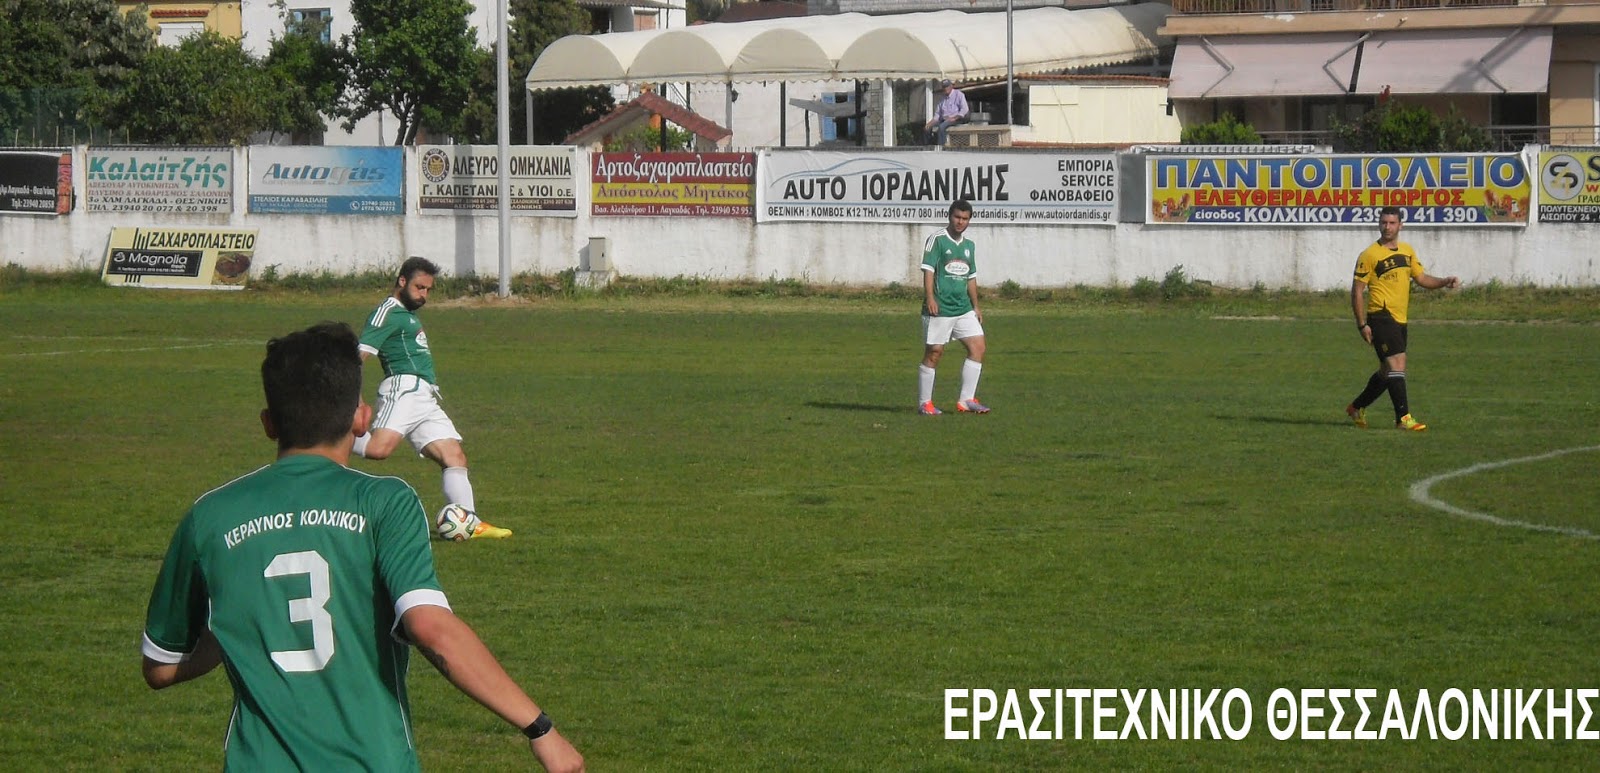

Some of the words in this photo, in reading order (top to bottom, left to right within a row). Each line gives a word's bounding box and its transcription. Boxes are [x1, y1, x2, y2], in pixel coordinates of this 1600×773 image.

[88, 156, 227, 188] Καλαϊτζής
[452, 156, 571, 176] ΑΛΕΥΡΟΟΜΗΧΑΝΙΑ
[595, 153, 753, 183] Αρτοζαχαροπλαστείο
[1058, 160, 1114, 172] ΕΜΠΟΡΙΑ
[1156, 156, 1525, 189] ΠΑΝΤΟΠΩΛΕΙΟ
[783, 176, 846, 200] AUTO
[862, 164, 1009, 200] ΙΟΡΔΑΝΙΔΗΣ
[1061, 175, 1114, 186] SERVICE
[423, 184, 433, 196] Γ.
[528, 185, 553, 196] ΥΙΟΙ
[597, 184, 678, 199] Απόστολος
[1030, 190, 1114, 202] ΦΑΝΟΒΑΦΕΙΟ
[1194, 189, 1363, 206] ΕΛΕΥΘΕΡΙΑΔΗΣ
[1370, 189, 1465, 206] ΓΙΩΡΓΟΣ
[610, 205, 646, 216] Αλεξάνδρου
[660, 205, 690, 216] Λαγκαδάς
[812, 206, 845, 217] ΚΟΜΒΟΣ
[847, 207, 861, 217] Κ12
[863, 208, 880, 218] ΤΗΛ.
[883, 208, 900, 218] 2310
[903, 208, 916, 218] 477
[918, 208, 932, 218] 080
[1024, 208, 1112, 220] www.autoiordanidis.gr
[1195, 208, 1240, 222] είσοδος
[1244, 207, 1346, 222] ΚΟΛΧΙΚΟΥ
[1351, 207, 1408, 222] 2390
[1414, 207, 1436, 222] 41
[1443, 207, 1478, 222] 390
[150, 232, 255, 249] ΖΑΧΑΡΟΠΛΑΣΤΕΙΟ
[128, 252, 188, 266] Magnolia
[224, 512, 294, 549] ΚΕΡΑΥΝΟΣ
[300, 509, 366, 533] ΚΟΛΧΙΚΟΥ
[264, 550, 335, 673] 3
